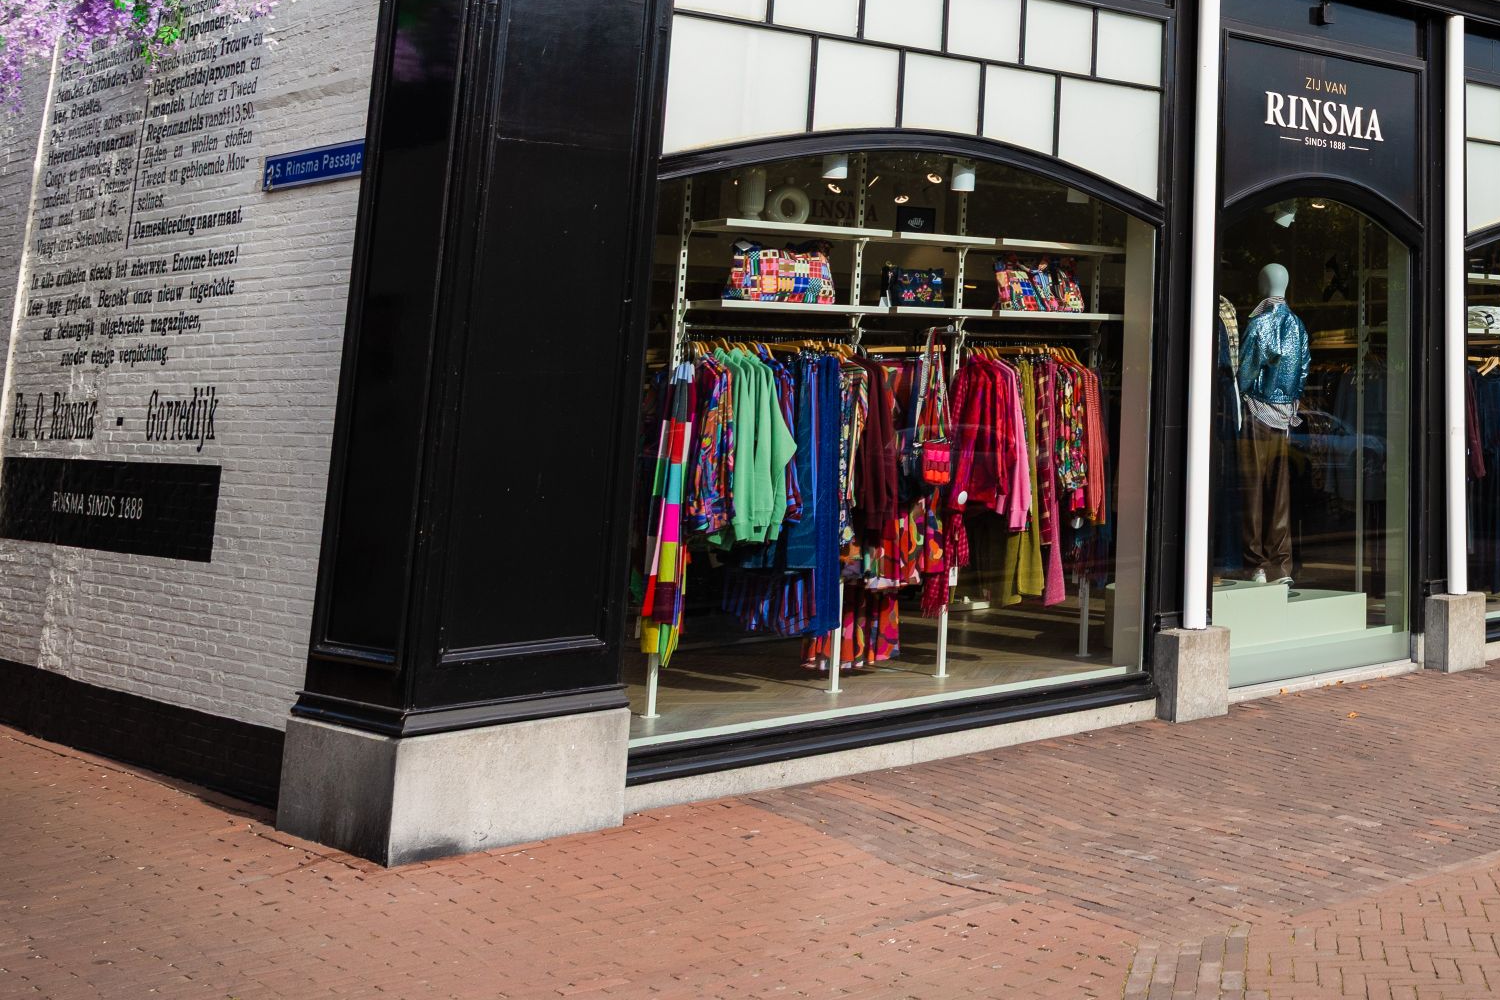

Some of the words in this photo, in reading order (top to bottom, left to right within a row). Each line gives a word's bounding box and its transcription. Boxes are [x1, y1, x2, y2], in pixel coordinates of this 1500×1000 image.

[220, 35, 252, 56] Trouw-
[253, 32, 263, 46] en
[250, 57, 261, 70] en
[189, 89, 214, 109] Loden
[218, 88, 228, 102] en
[230, 77, 258, 99] Tweed
[1305, 77, 1321, 91] ZIJ
[1325, 80, 1347, 95] VAN
[146, 118, 203, 143] Regenmantels
[1264, 90, 1384, 142] RINSMA
[174, 144, 183, 158] en
[192, 135, 218, 154] wollen
[224, 128, 253, 148] stoffen
[1304, 136, 1327, 148] SINDS
[1329, 140, 1346, 150] 1888
[141, 167, 167, 187] Tweed
[170, 168, 178, 183] en
[180, 156, 225, 185] gebloemde
[286, 159, 319, 177] Rinsma
[322, 152, 361, 170] Passage
[133, 214, 195, 239] Dameskleeding
[197, 213, 218, 229] naar
[56, 266, 86, 287] artikelen
[89, 262, 112, 281] steeds
[115, 259, 128, 278] het
[172, 253, 206, 272] Enorme
[207, 244, 240, 268] keuze!
[46, 298, 62, 318] lage
[65, 294, 92, 316] prijzen.
[97, 287, 128, 308] Bezoekt
[133, 289, 152, 304] onze
[157, 283, 184, 302] nieuw
[189, 276, 235, 303] ingerichte
[43, 327, 52, 340] en
[57, 317, 95, 341] belangrijk
[100, 316, 145, 339] uitgebreide
[150, 311, 201, 336] magazijnen,
[60, 347, 88, 366] zonder
[91, 346, 114, 368] eenige
[119, 343, 169, 368] verplichting.
[11, 392, 28, 439] Fa.
[34, 392, 45, 440] O.
[50, 391, 98, 440] Rinsma
[146, 386, 219, 453] Gorredijk
[51, 491, 84, 516] RINSMA
[86, 494, 115, 518] SINDS
[118, 497, 144, 520] 1888
